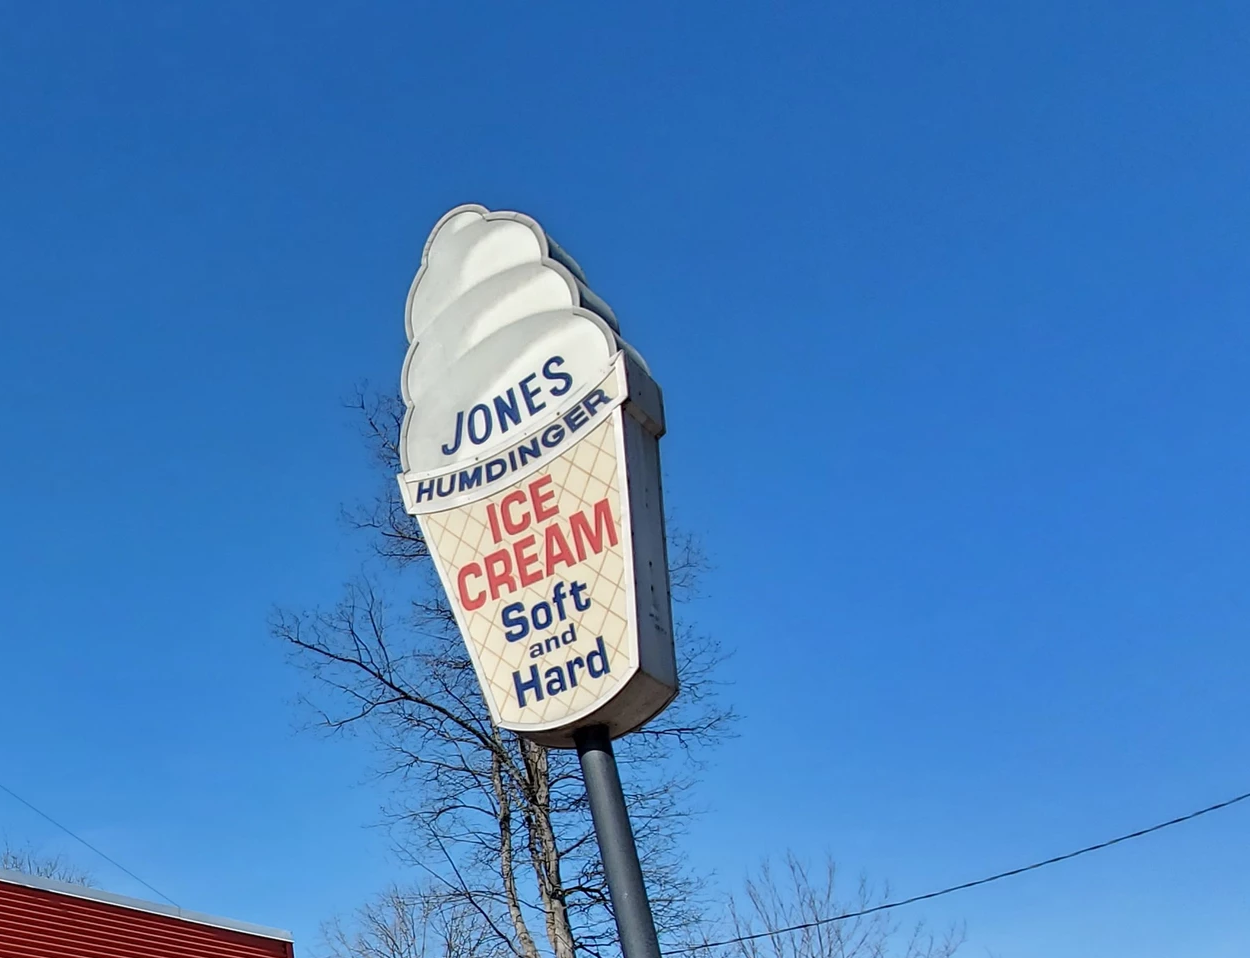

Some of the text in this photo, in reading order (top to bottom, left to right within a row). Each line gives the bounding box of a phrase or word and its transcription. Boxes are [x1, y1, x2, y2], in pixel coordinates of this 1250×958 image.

[442, 356, 573, 455] JONES
[416, 388, 612, 503] HUMDINGER
[486, 473, 559, 545] ICE
[457, 498, 619, 611] CREAM
[501, 580, 592, 642] Soft
[529, 624, 577, 659] and
[512, 637, 611, 708] Hard
